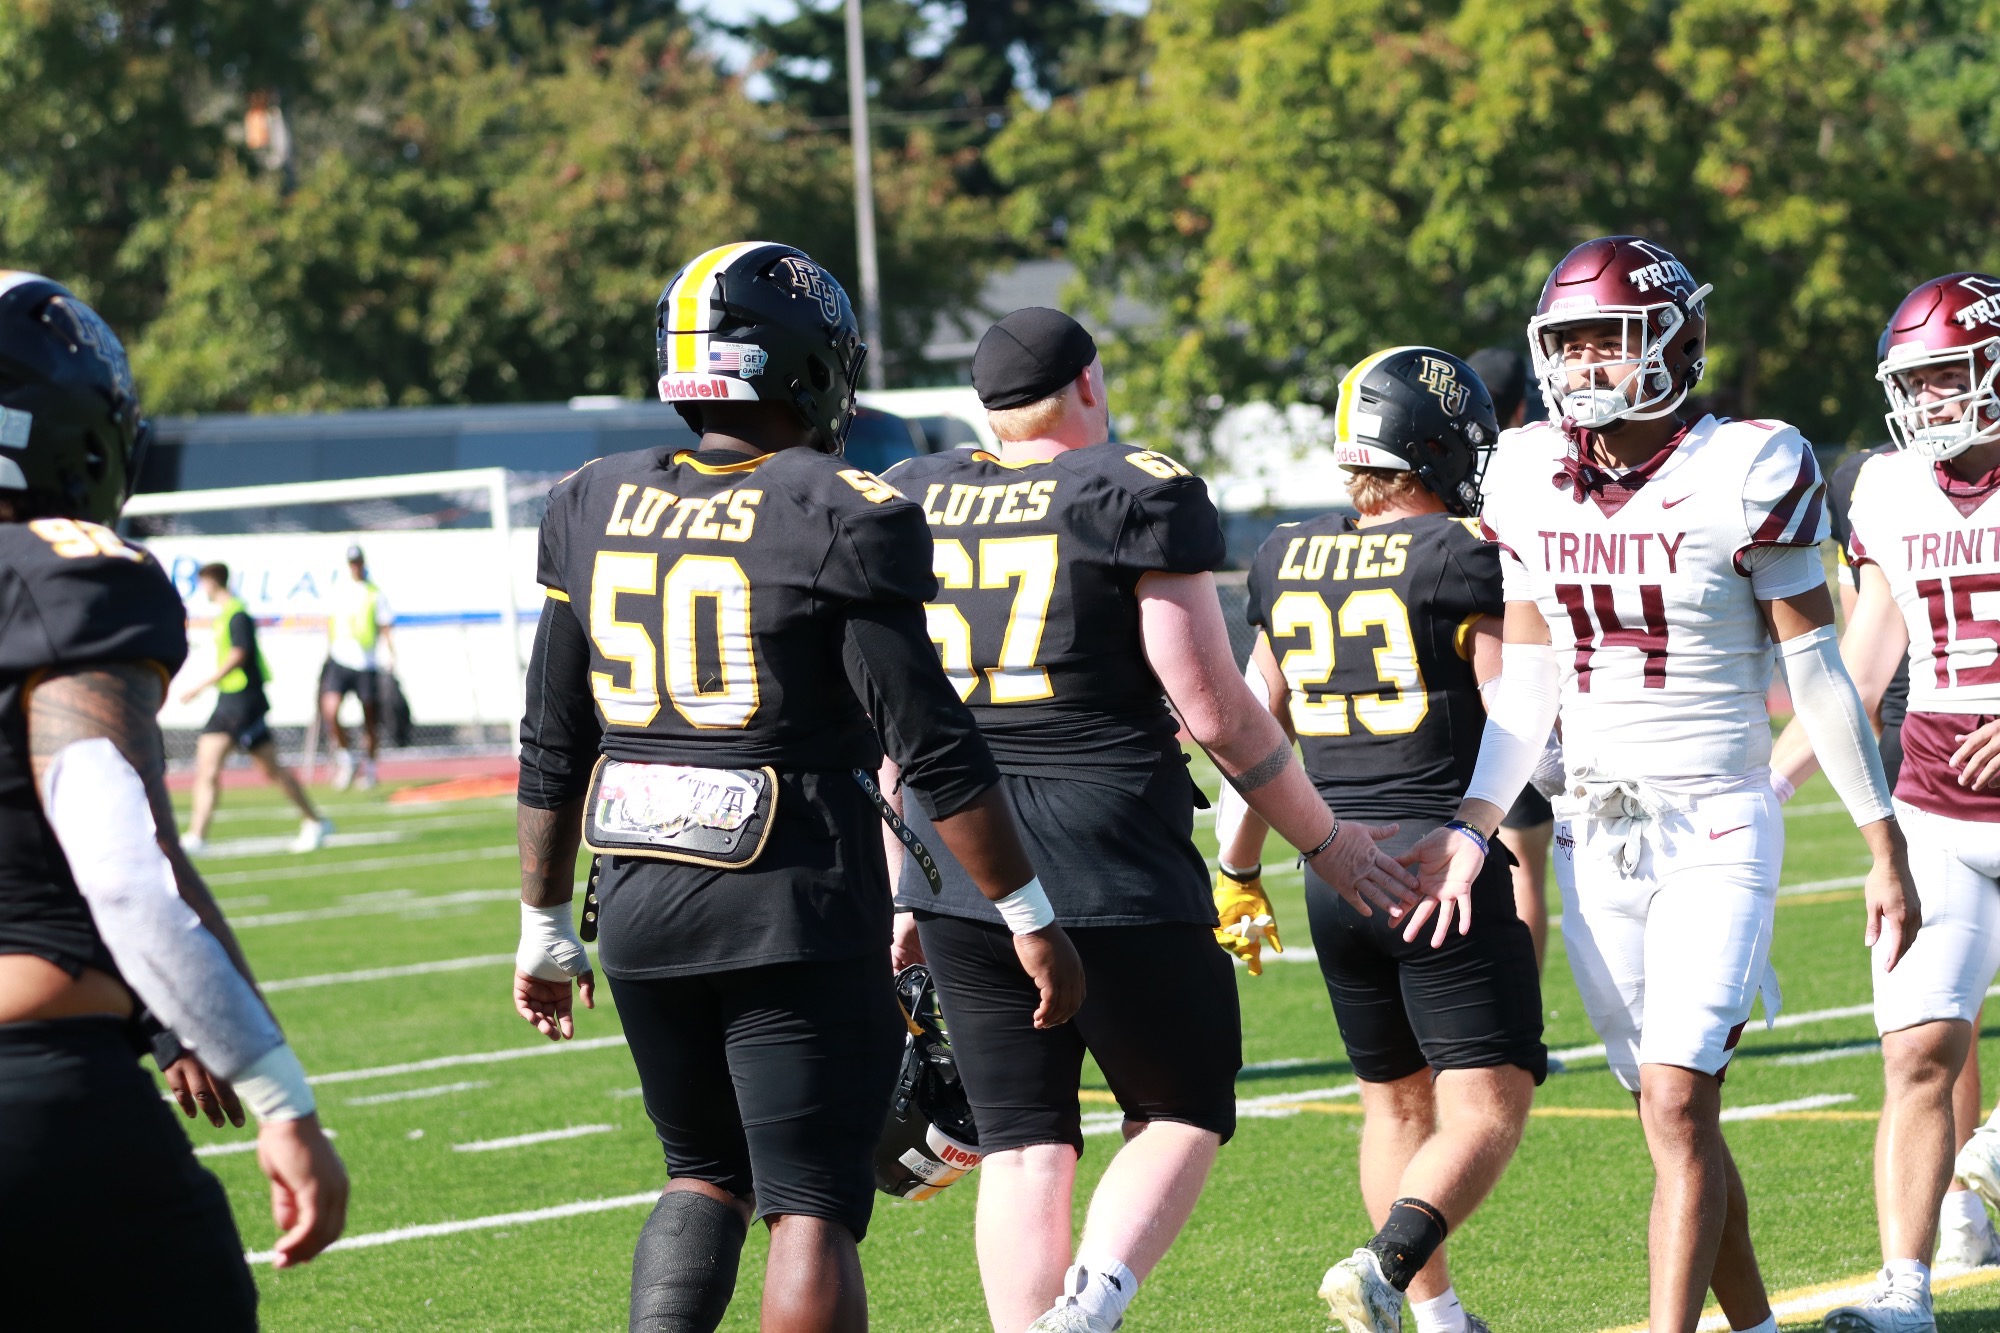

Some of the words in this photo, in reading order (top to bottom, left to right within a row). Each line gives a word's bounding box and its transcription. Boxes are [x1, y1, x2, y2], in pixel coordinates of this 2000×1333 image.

[780, 256, 842, 324] PLU
[1628, 260, 1694, 293] TRIN
[1955, 293, 2000, 331] TRI
[743, 354, 764, 363] GET
[661, 379, 729, 398] Riddell
[1419, 355, 1470, 417] PLU
[1336, 447, 1371, 465] ddell
[605, 483, 764, 543] LUTES
[925, 479, 1058, 526] LUTES
[1277, 533, 1413, 581] LUTES
[1538, 530, 1687, 575] TRINITY
[1902, 526, 2000, 572] TRINIT
[590, 550, 761, 729] 50
[923, 534, 1059, 704] 67
[1554, 583, 1669, 694] 14
[1915, 572, 2000, 690] 15
[1271, 587, 1430, 737] 23
[915, 1165, 934, 1176] GET
